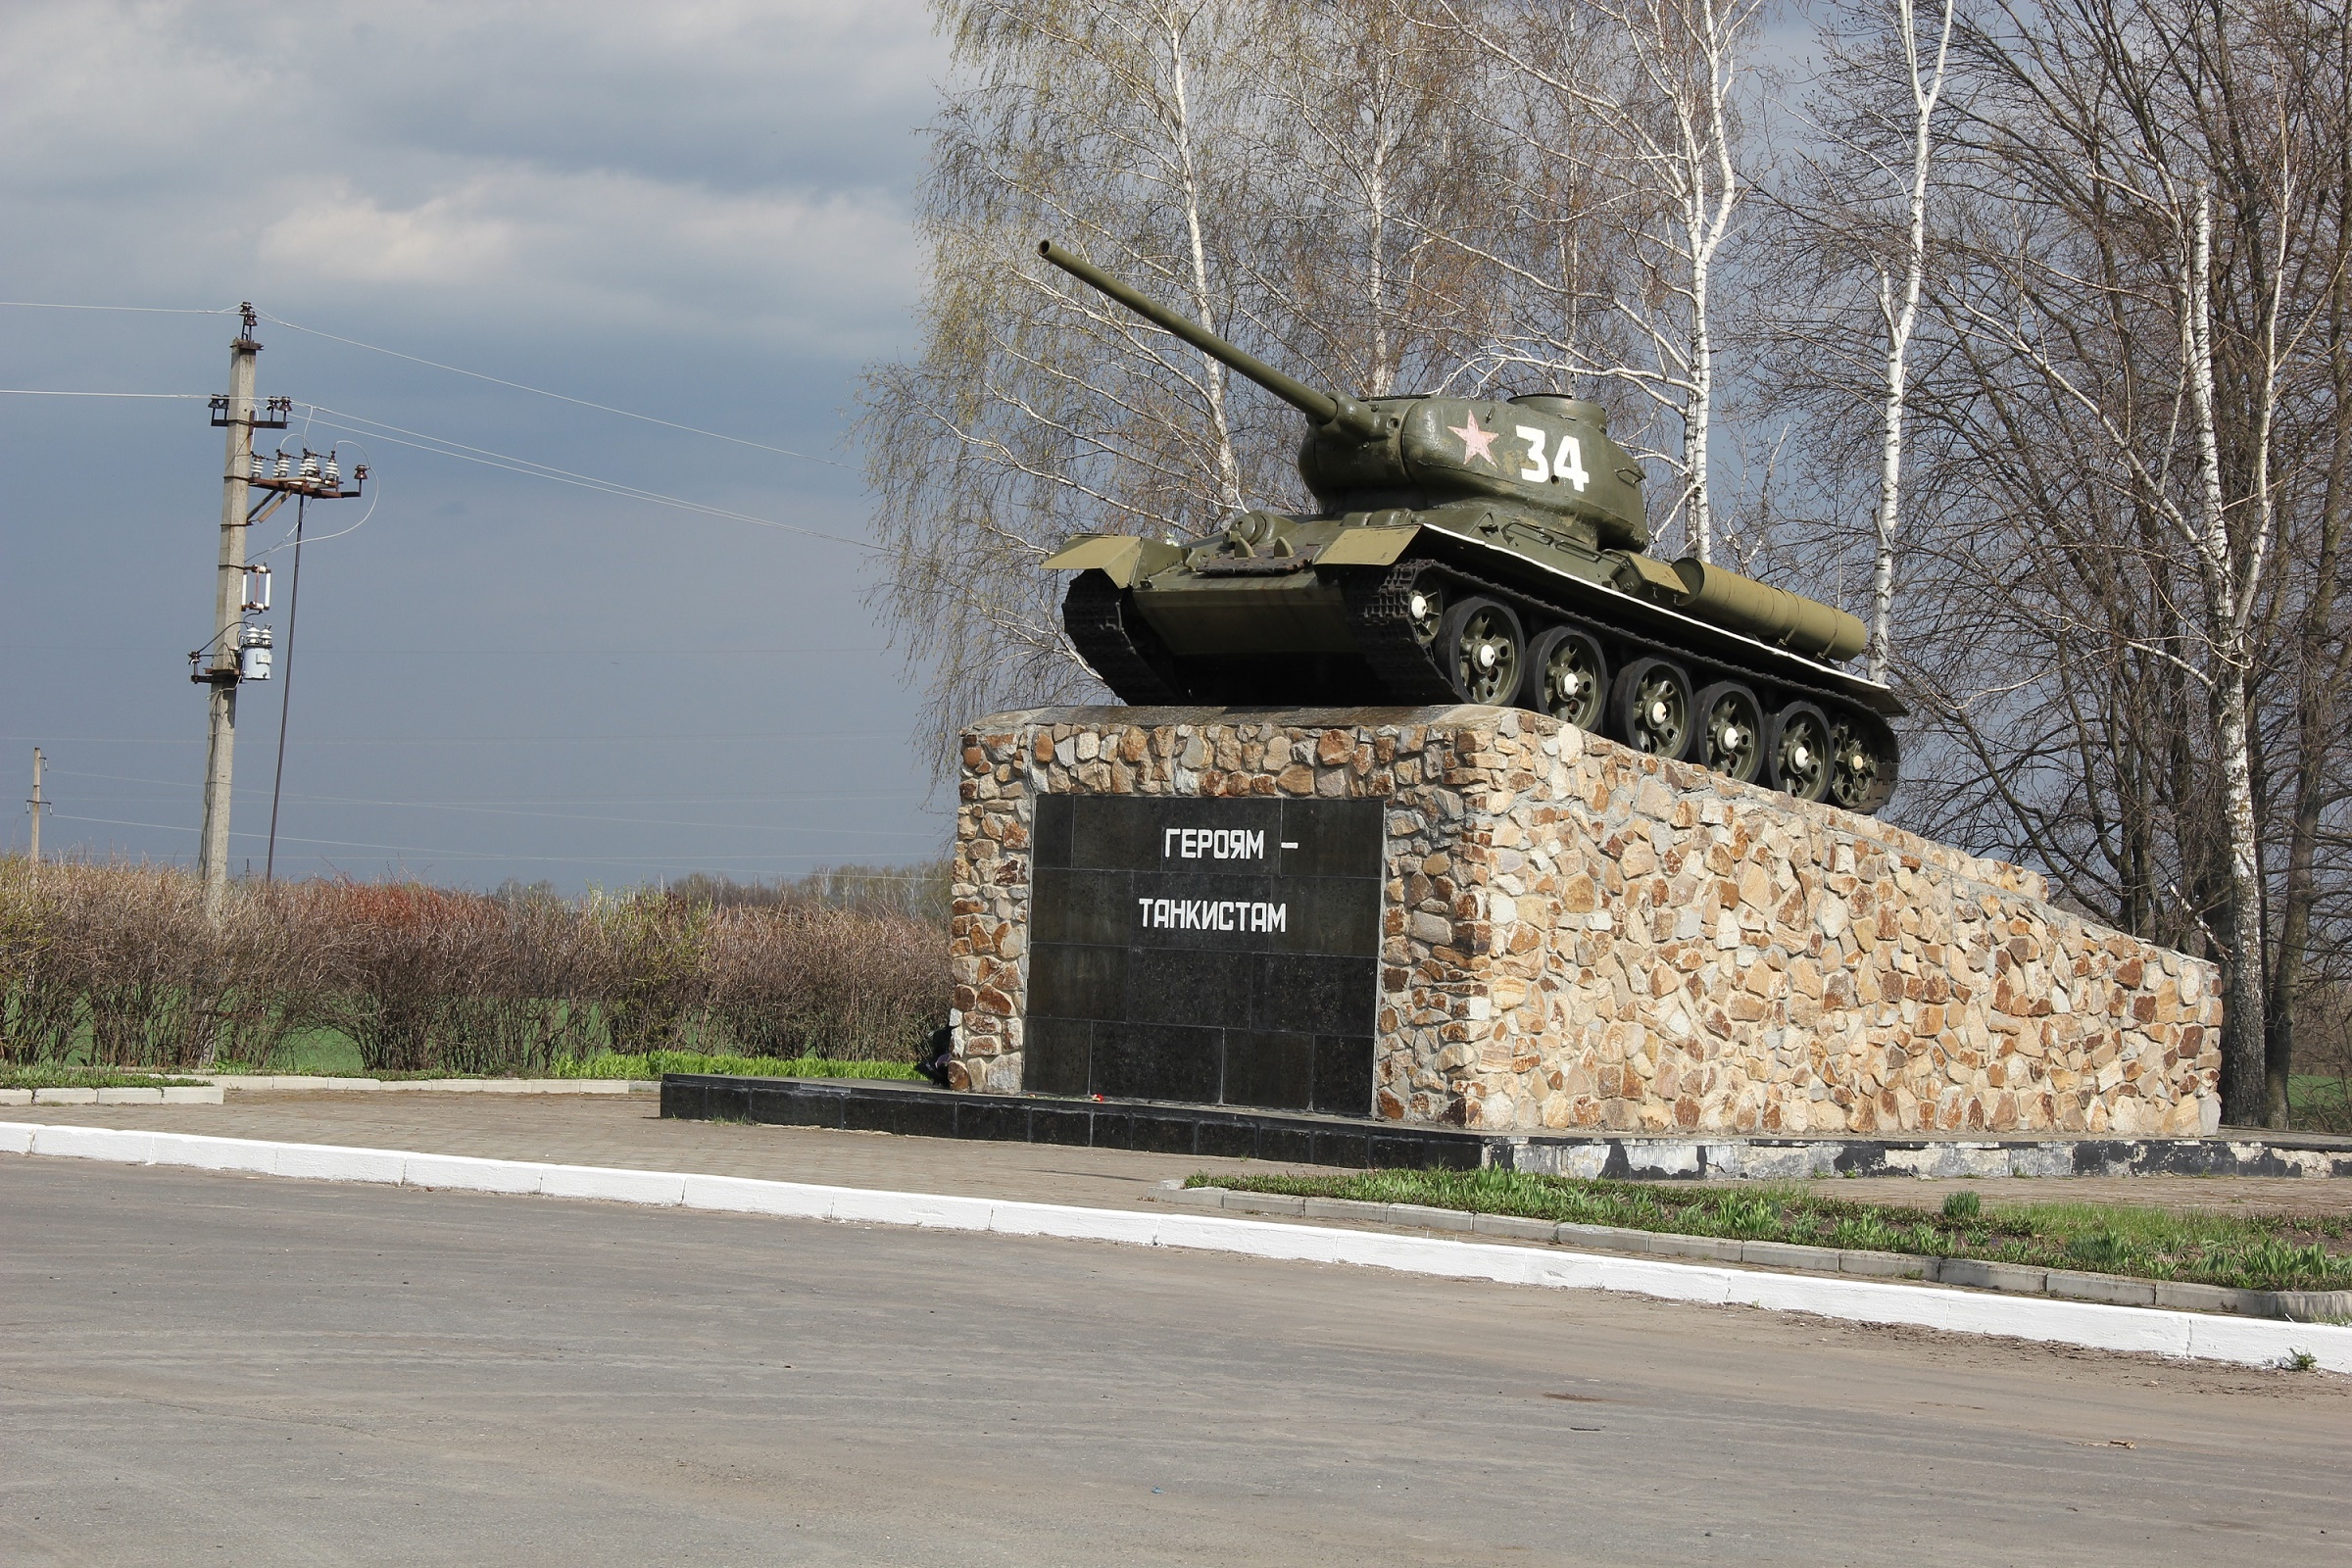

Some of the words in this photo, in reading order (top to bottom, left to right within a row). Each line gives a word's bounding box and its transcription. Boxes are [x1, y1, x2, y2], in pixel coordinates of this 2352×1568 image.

[1515, 424, 1590, 492] 34
[1164, 828, 1264, 859] ГЕРОЯМ
[1138, 898, 1287, 933] ТАНКИСТАМ
